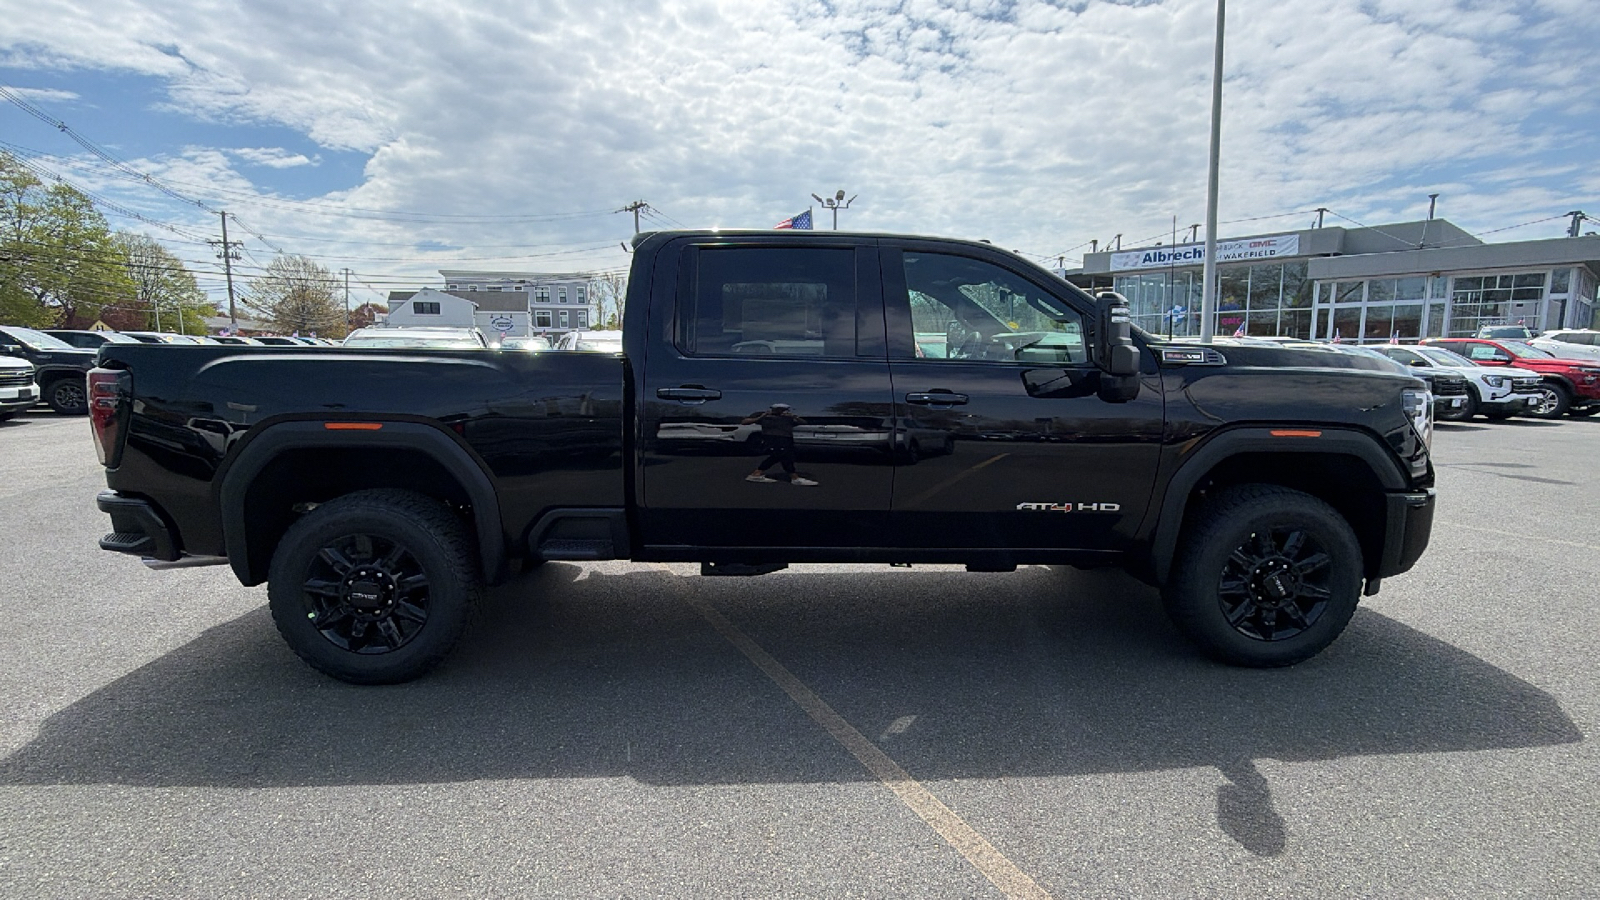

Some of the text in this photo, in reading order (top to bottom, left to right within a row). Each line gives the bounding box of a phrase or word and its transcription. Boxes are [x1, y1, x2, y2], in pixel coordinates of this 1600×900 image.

[1249, 239, 1277, 249] GMC
[1223, 250, 1276, 260] WAKEFIELD
[1221, 316, 1242, 326] GMC
[1016, 502, 1121, 513] AT4 HD
